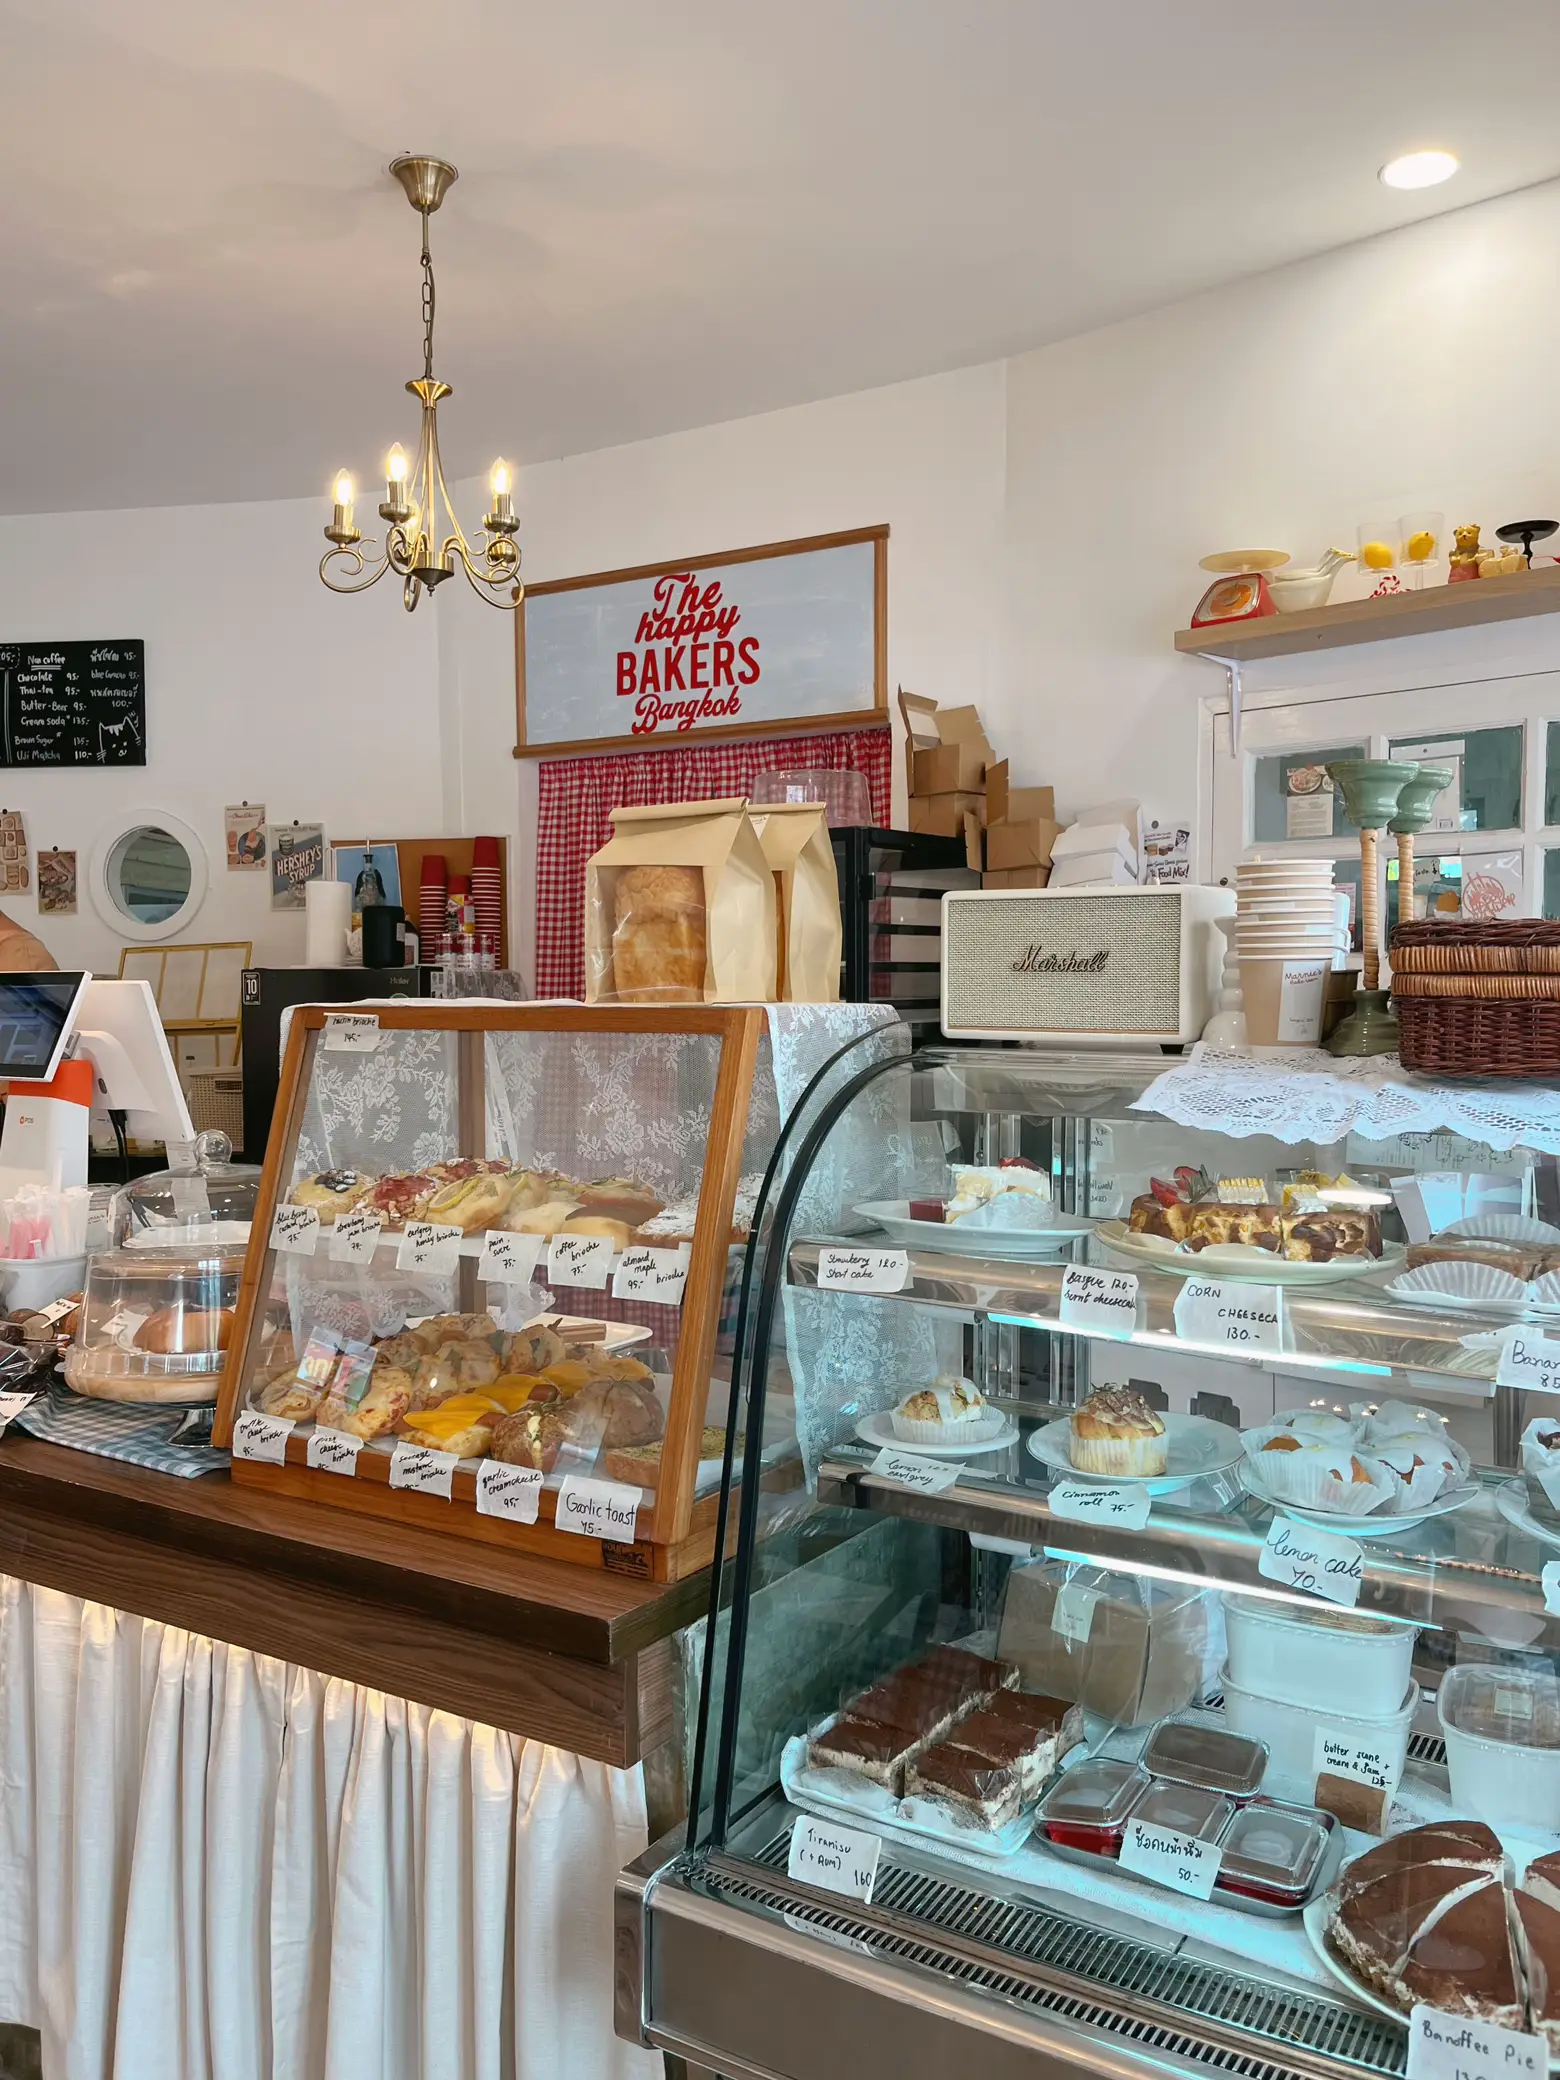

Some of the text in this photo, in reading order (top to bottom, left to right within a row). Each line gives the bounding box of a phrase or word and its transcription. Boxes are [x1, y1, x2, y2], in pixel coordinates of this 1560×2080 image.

[653, 572, 723, 623] The
[634, 605, 741, 647] happy
[43, 652, 66, 665] coffee
[616, 636, 760, 697] BAKERS
[17, 671, 53, 682] Chocolate
[631, 686, 742, 735] Bangkok
[21, 717, 45, 727] Cream
[276, 844, 322, 877] HERSHEY'S
[289, 864, 316, 883] SYRUP
[1157, 866, 1172, 879] Food
[1172, 864, 1190, 879] Mix!
[1011, 943, 1110, 973] Marshall
[246, 979, 257, 994] 10
[436, 1229, 460, 1242] brioche
[555, 1241, 577, 1259] coffee
[571, 1241, 600, 1262] brioche
[622, 1250, 651, 1268] almond
[634, 1261, 657, 1274] maple
[827, 1253, 871, 1269] Strawberry
[656, 1269, 685, 1284] brioche
[850, 1267, 875, 1279] cake
[1066, 1271, 1106, 1291] Basque
[1186, 1284, 1222, 1299] CORN
[482, 1468, 510, 1489] garlic
[1079, 1497, 1102, 1507] roll
[605, 1501, 636, 1527] toast
[1266, 1529, 1362, 1579] lemon cake
[1323, 1740, 1349, 1756] butter
[1327, 1757, 1349, 1769] cream
[807, 1827, 851, 1854] Tiramisu
[1422, 2019, 1535, 2070] Banoffee Pie
